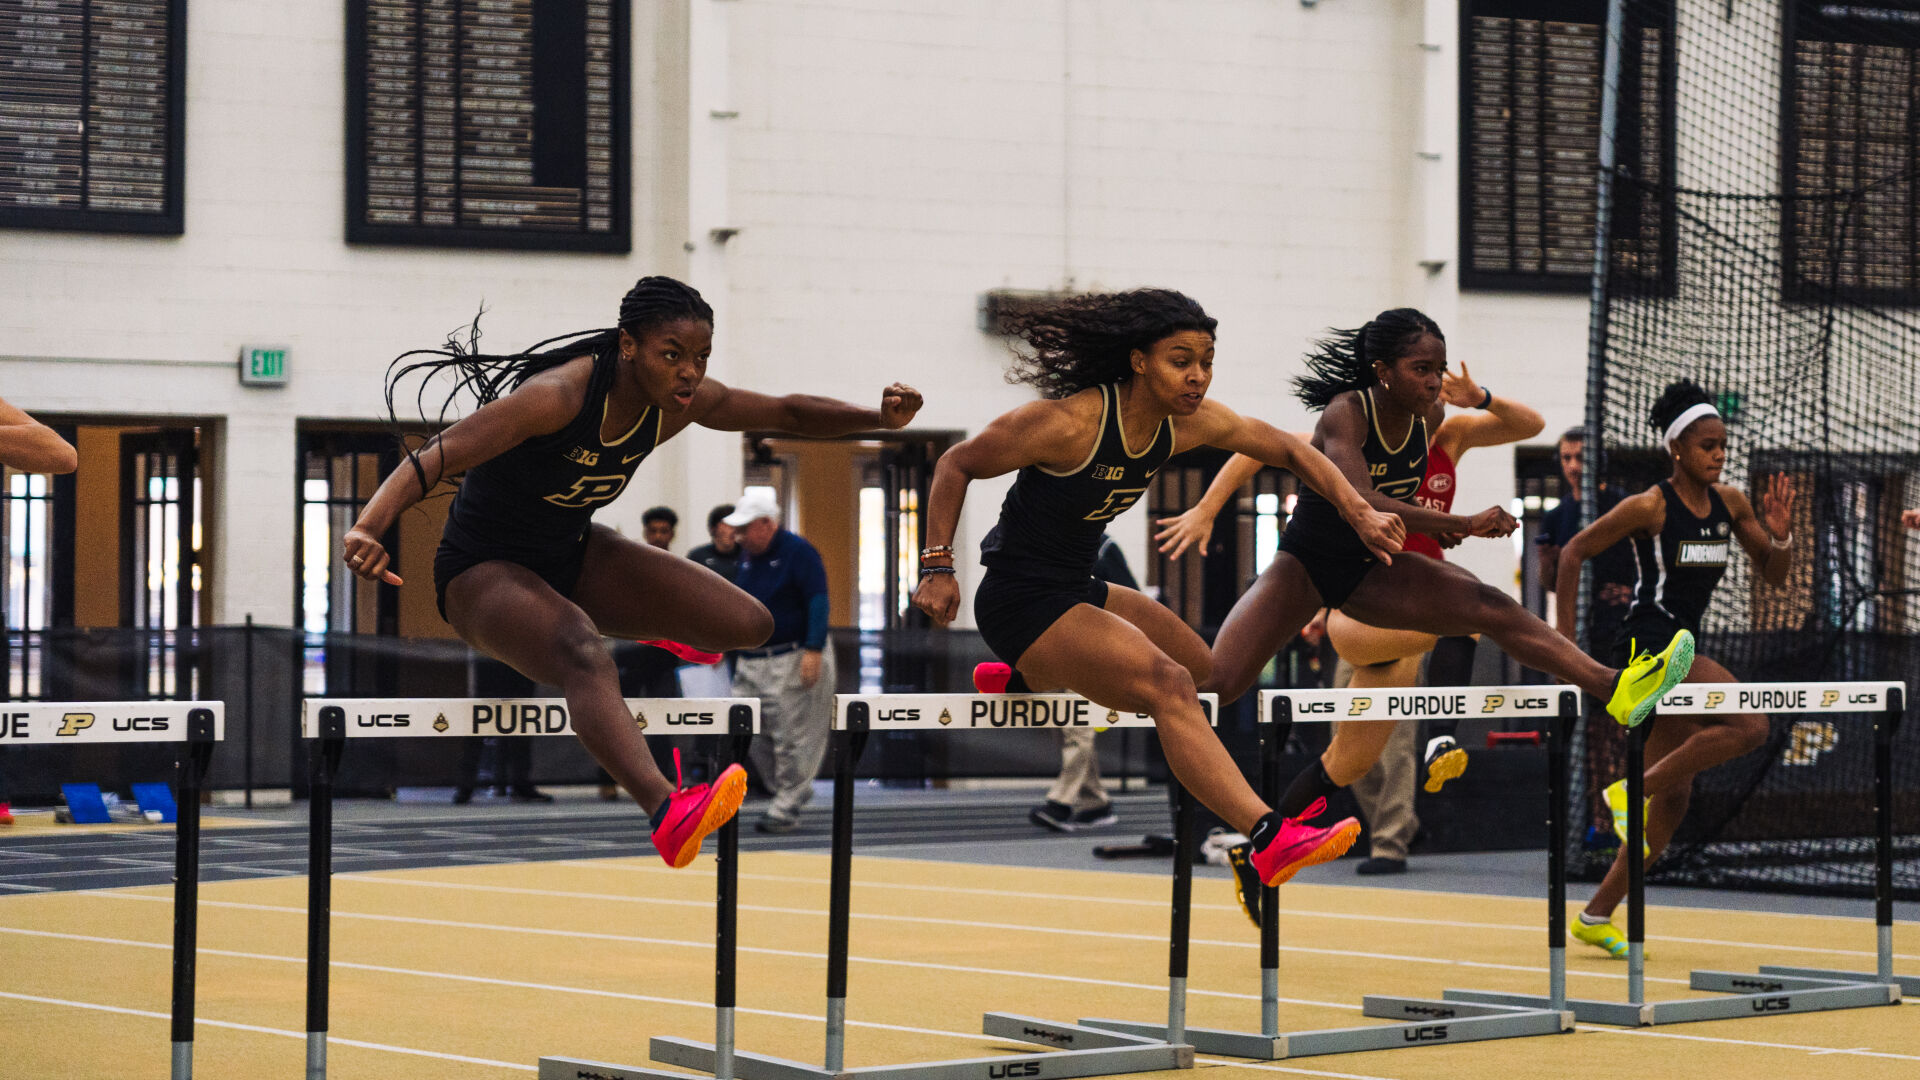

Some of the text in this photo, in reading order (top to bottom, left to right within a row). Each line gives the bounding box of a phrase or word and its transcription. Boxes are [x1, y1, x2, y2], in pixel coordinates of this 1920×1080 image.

[251, 349, 285, 377] EXIT
[1298, 702, 1336, 714] UCS
[1388, 695, 1467, 716] PURDUE
[1513, 698, 1549, 710] UCS
[1661, 695, 1694, 707] UCS
[1739, 690, 1808, 709] PURDUE
[1848, 693, 1878, 705] UCS
[357, 704, 715, 734] UCS PURD UCS
[877, 700, 1090, 728] UCS PURDUE
[112, 716, 170, 732] UCS
[1752, 996, 1790, 1012] UCS
[1404, 1025, 1448, 1042] UCS
[989, 1061, 1040, 1079] UCS
